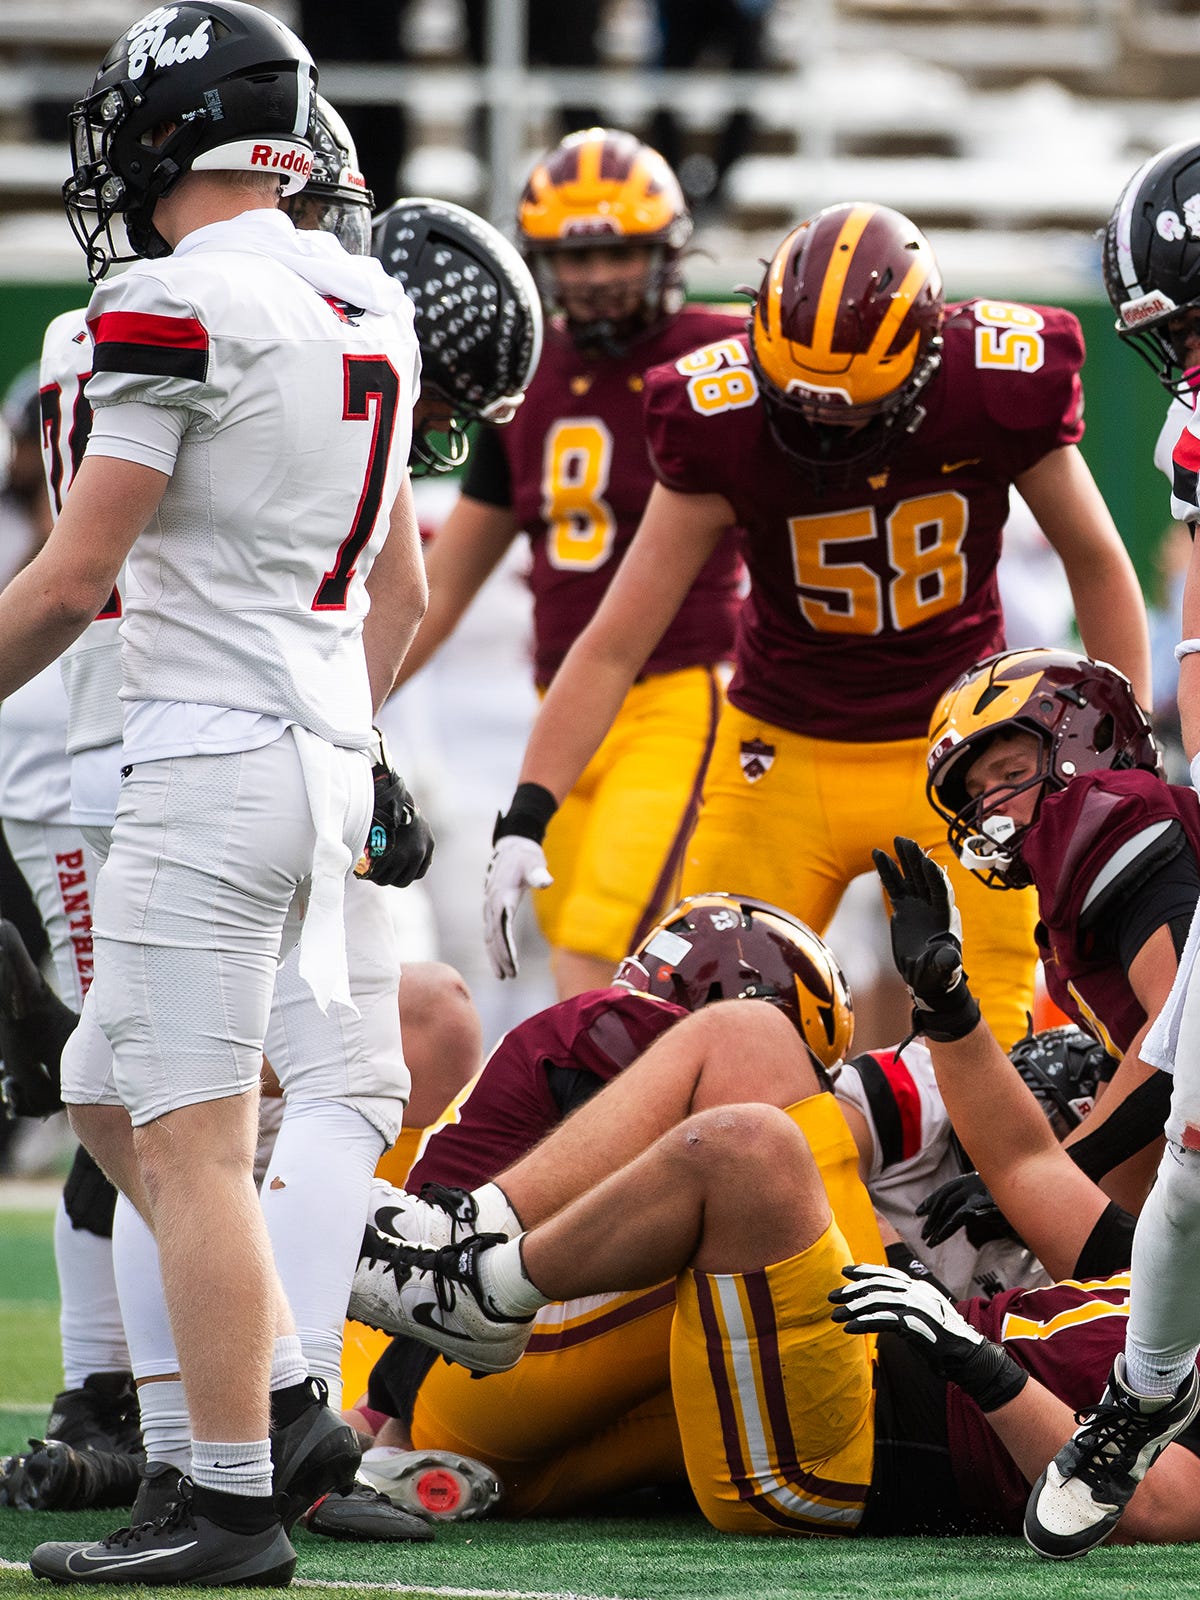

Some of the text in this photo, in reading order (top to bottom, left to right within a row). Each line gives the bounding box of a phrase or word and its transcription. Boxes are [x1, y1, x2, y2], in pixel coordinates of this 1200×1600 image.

[675, 338, 760, 416] 58
[974, 300, 1046, 374] 58
[312, 353, 401, 612] 7
[541, 415, 618, 573] 8
[788, 490, 969, 636] 58
